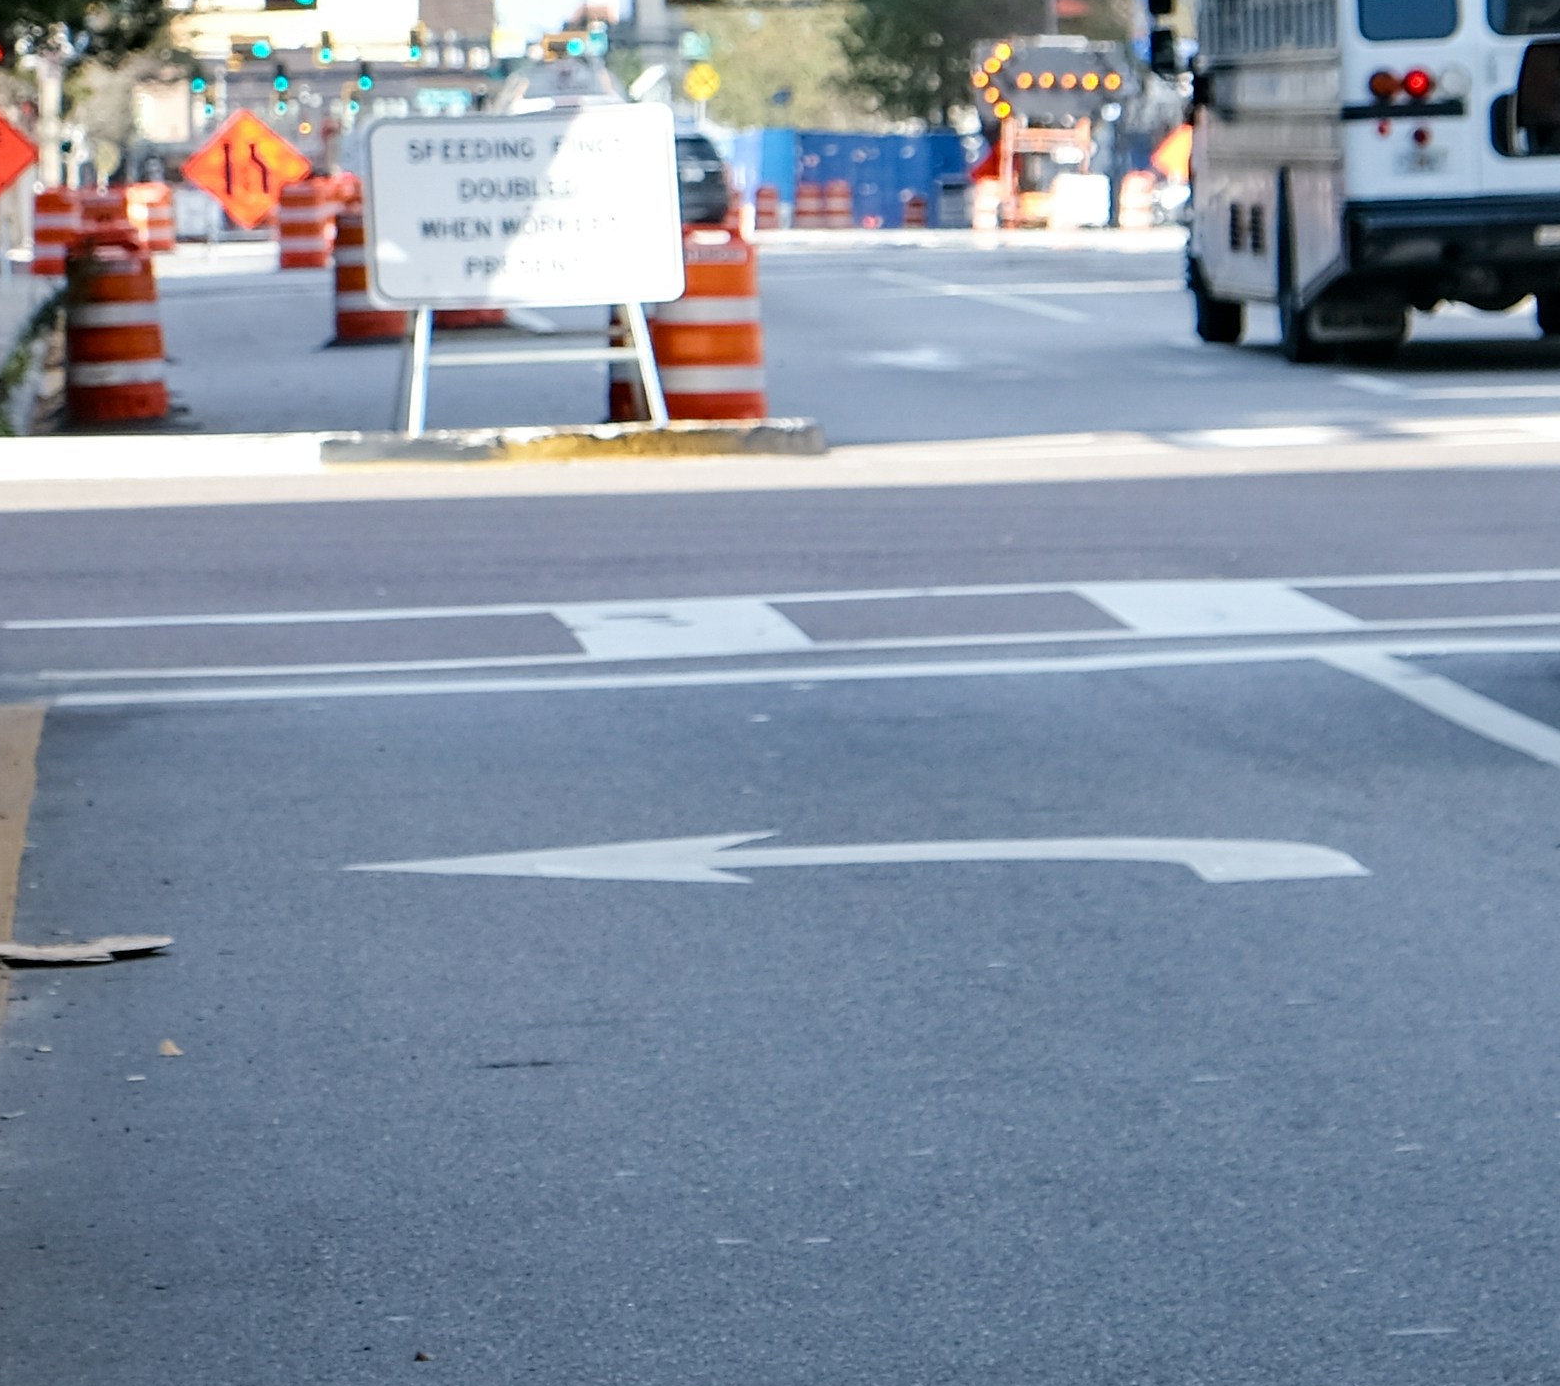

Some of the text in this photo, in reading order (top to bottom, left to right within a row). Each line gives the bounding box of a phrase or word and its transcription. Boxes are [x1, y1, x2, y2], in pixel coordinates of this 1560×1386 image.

[405, 134, 623, 164] SPEEDING FINE
[417, 213, 620, 242] WHEN WORK
[463, 254, 585, 281] PREN
